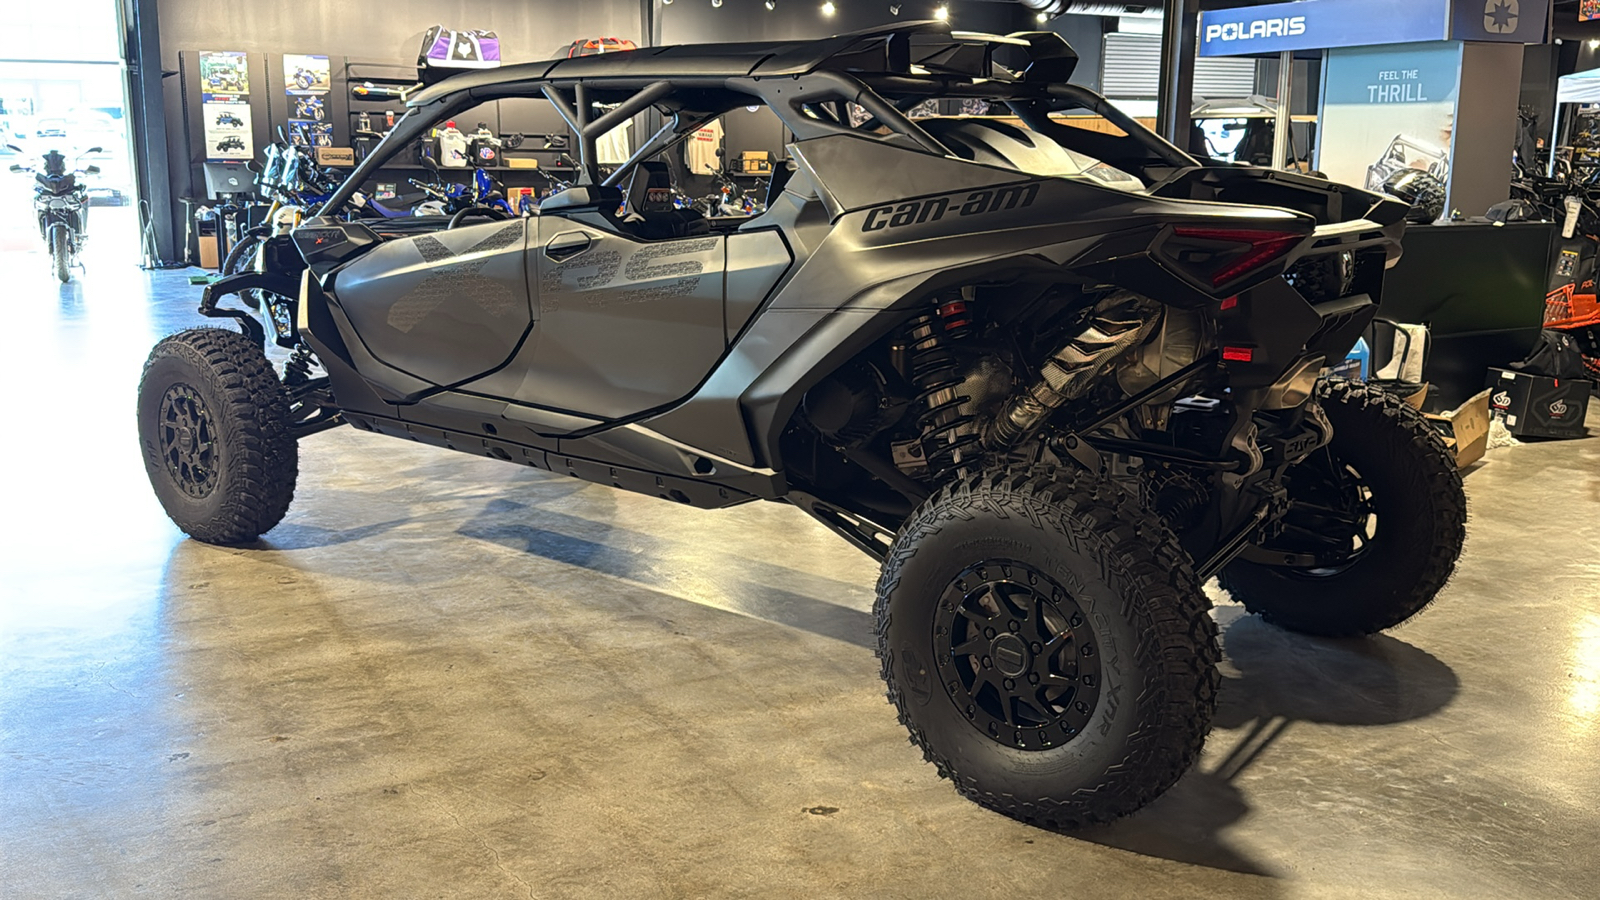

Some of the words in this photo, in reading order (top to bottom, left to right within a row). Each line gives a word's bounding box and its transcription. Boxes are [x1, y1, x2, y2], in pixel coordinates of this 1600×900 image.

[1206, 16, 1306, 43] POLARIS
[1379, 71, 1399, 81] FEEL
[1401, 69, 1419, 80] THE
[1367, 83, 1428, 103] THRILL
[861, 183, 1041, 232] can-am
